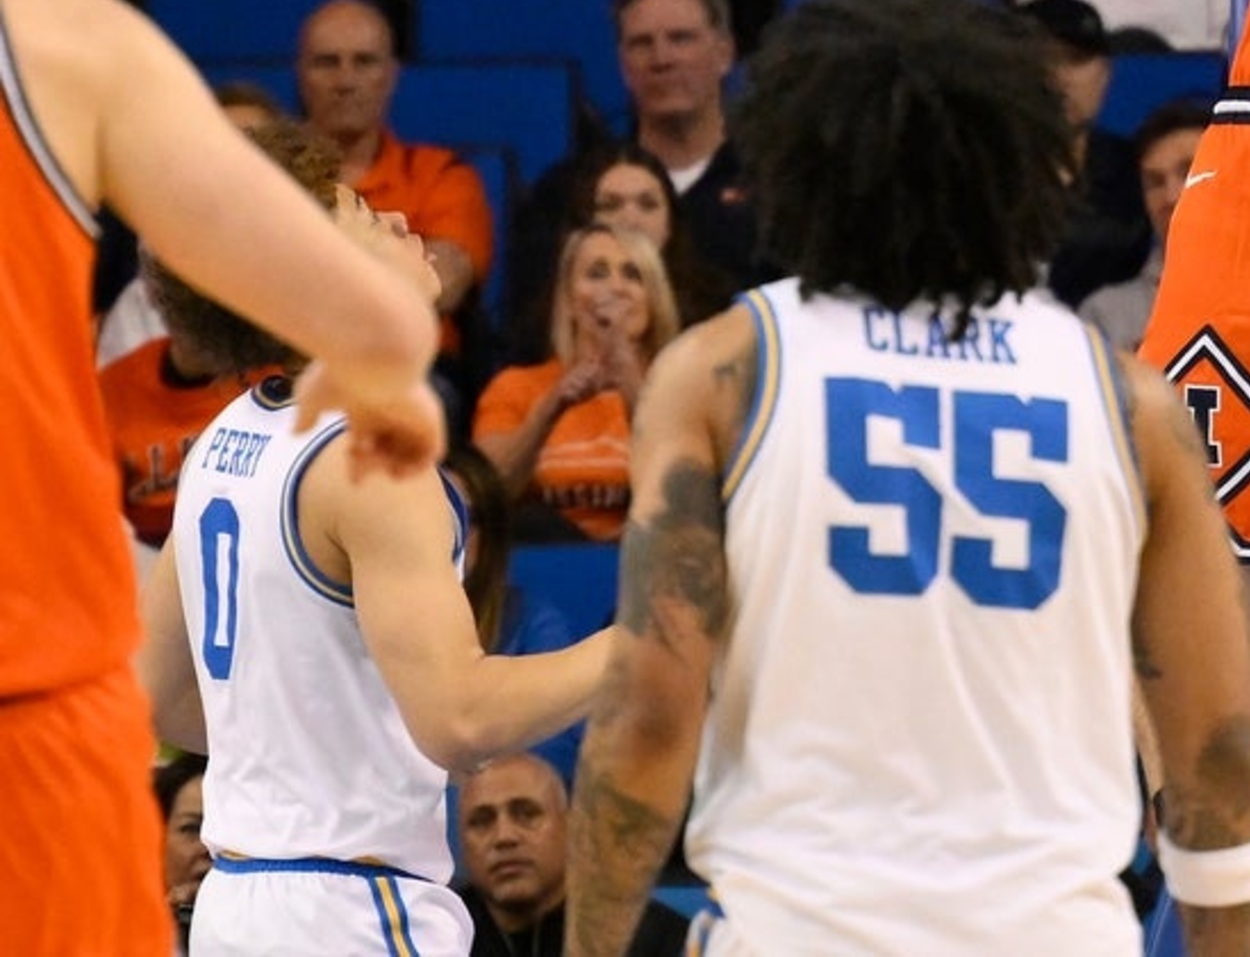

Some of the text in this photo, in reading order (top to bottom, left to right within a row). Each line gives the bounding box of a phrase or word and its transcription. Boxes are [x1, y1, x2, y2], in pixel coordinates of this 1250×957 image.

[863, 305, 1017, 365] CLARK
[202, 426, 273, 478] PERRY
[823, 376, 1069, 611] 55
[198, 496, 241, 682] 0
